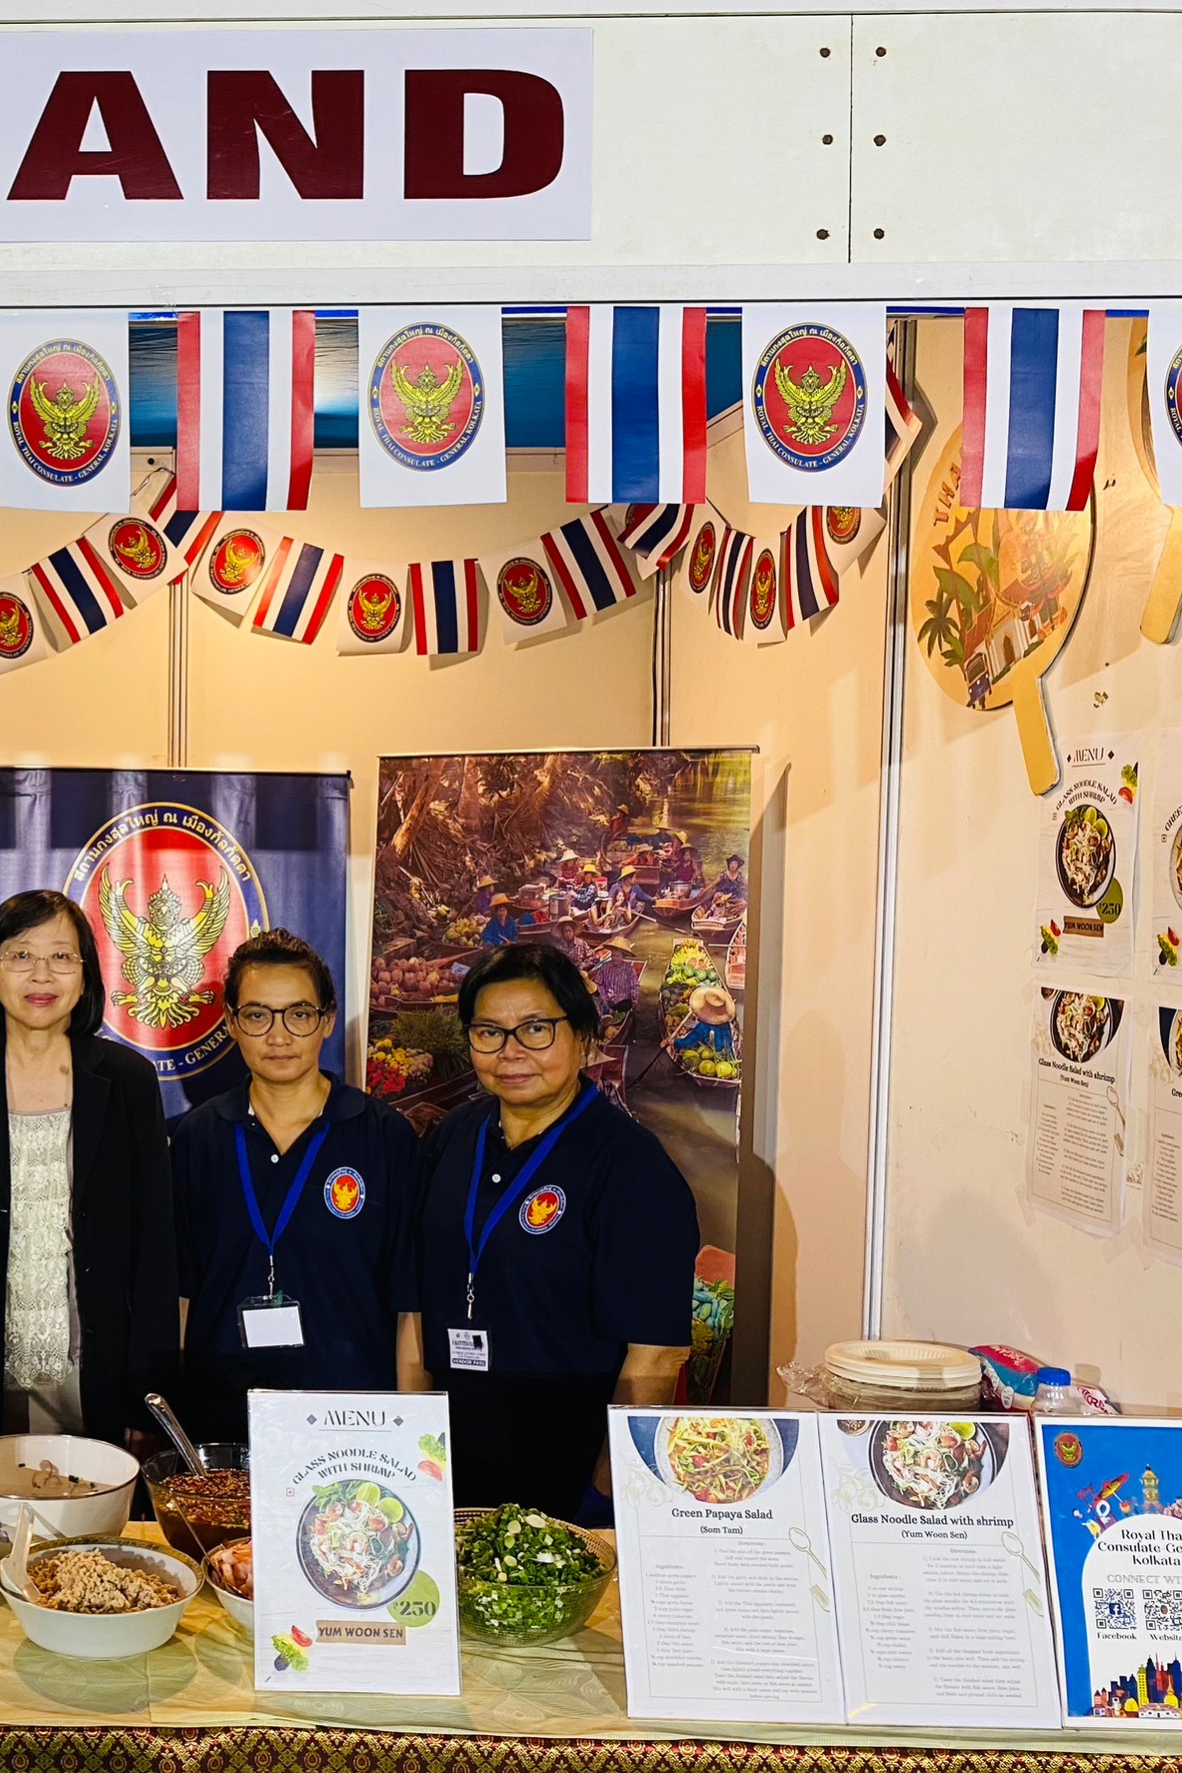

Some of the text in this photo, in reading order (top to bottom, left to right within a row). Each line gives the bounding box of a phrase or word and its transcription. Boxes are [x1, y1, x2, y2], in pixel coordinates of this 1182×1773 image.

[1170, 407, 1181, 435] ROYAL
[372, 408, 385, 434] ROYAL
[382, 434, 395, 453] THAI
[393, 450, 435, 468] CONSULATE
[466, 401, 482, 436] KOLKATA
[756, 406, 768, 431] ROYAL
[766, 432, 780, 449] THAI
[778, 448, 818, 468] CONSULATE
[848, 404, 864, 438] KOLKATA
[13, 422, 24, 446] ROYAL
[22, 447, 35, 465] THAI
[33, 462, 74, 482] CONSULATE
[104, 419, 118, 453] KOLKATA
[934, 462, 961, 527] THA
[1073, 748, 1105, 762] MENU
[74, 809, 252, 882] สถานกงสุลใหญ่ ณ เมืองกัลกัตตา
[184, 1024, 229, 1065] GENERA
[324, 1410, 386, 1426] MENU
[292, 1448, 417, 1485] GLASS NOODLE SALAD
[318, 1462, 396, 1479] WITH SHRIMP
[672, 1508, 774, 1520] Green Papaya Salad
[851, 1514, 1014, 1528] Glass Noodle Salad with shrimp
[700, 1525, 744, 1535] (Som Tam)
[902, 1530, 968, 1540] (Yum Woon Sen)
[1122, 1529, 1182, 1542] Royal Tha
[1132, 1554, 1181, 1566] Kolkata
[1107, 1574, 1182, 1584] CONNECT WI
[318, 1627, 404, 1638] YUM WOON SEN
[1098, 1632, 1138, 1640] Facebook
